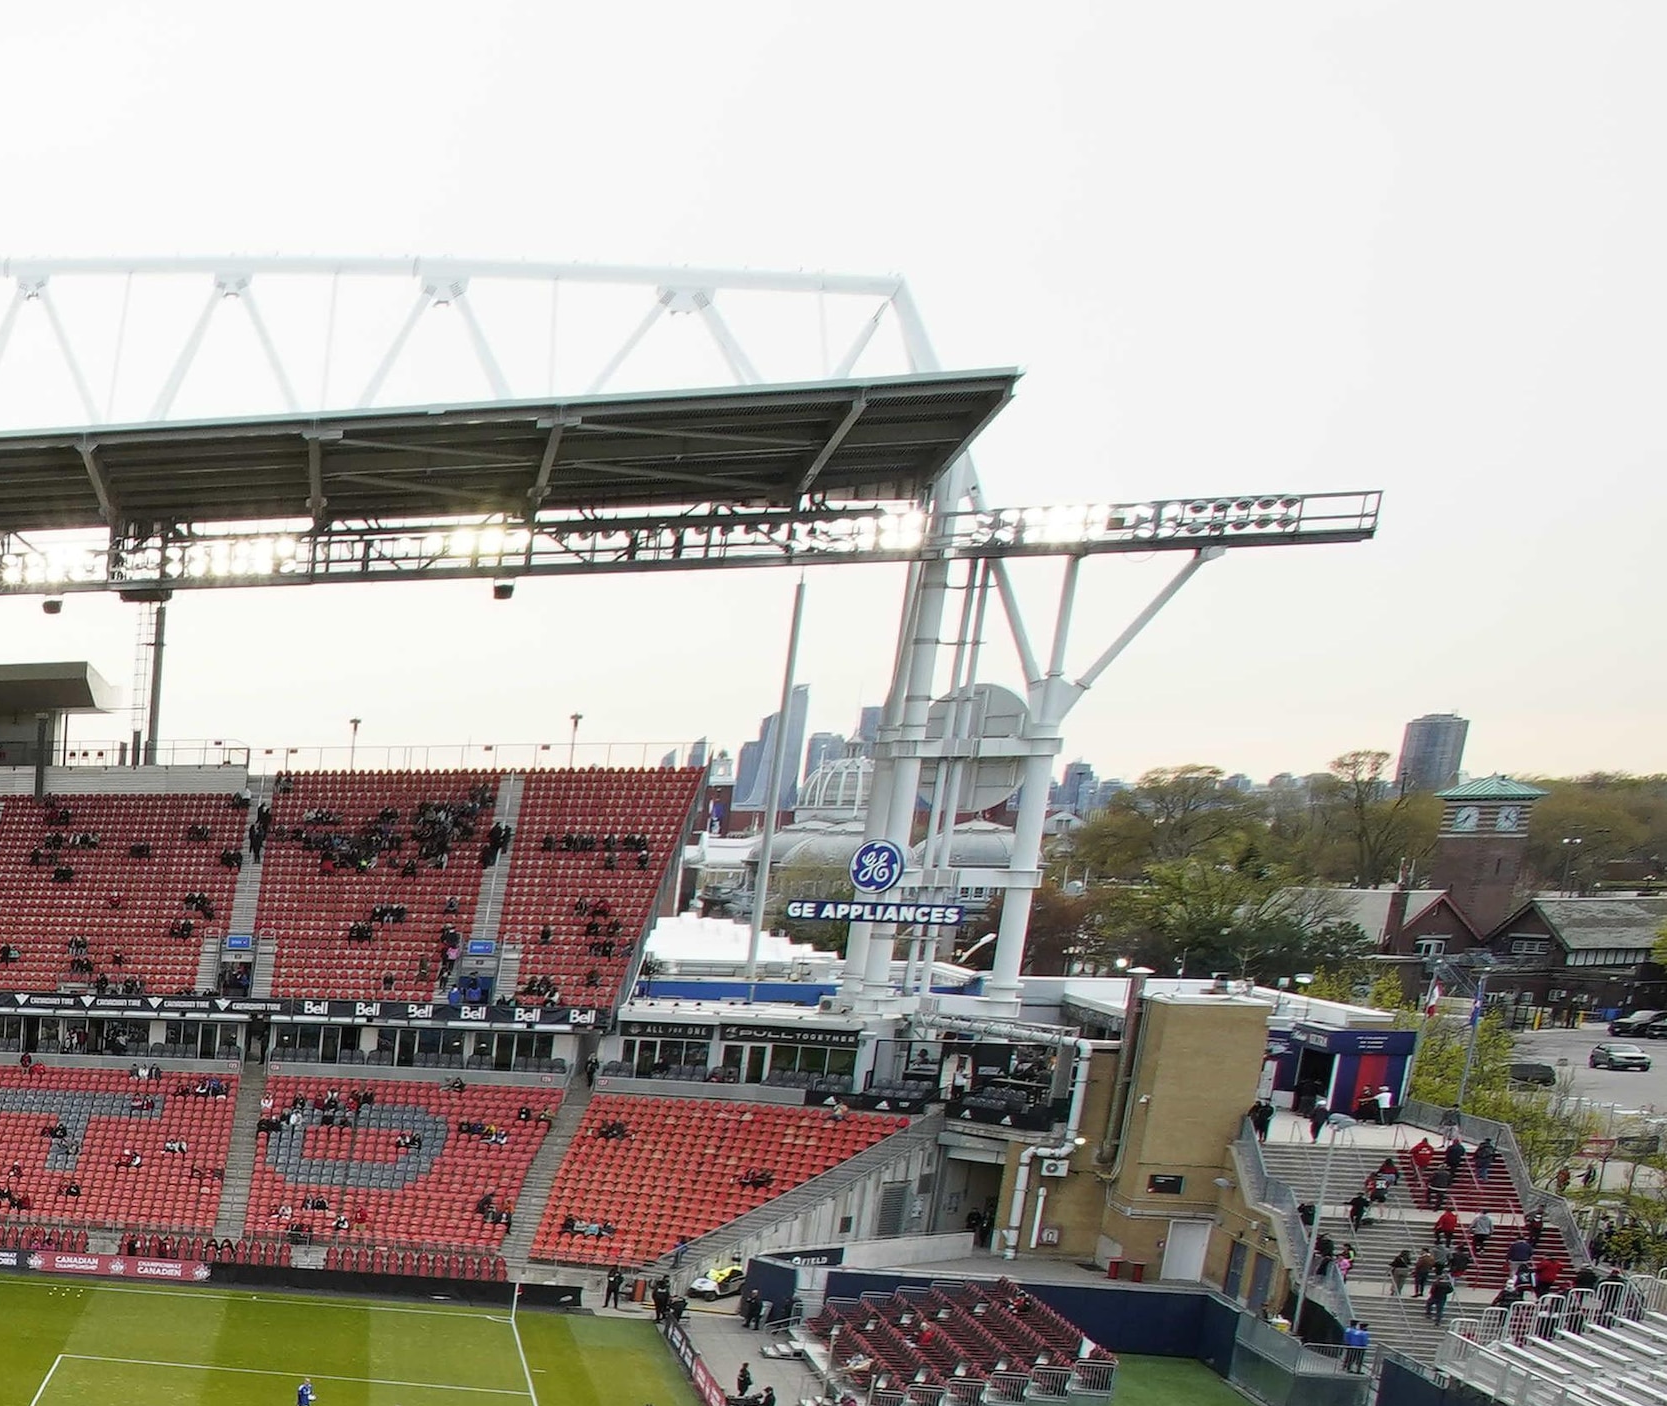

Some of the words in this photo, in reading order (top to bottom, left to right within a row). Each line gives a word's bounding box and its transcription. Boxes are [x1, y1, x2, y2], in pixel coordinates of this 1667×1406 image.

[787, 902, 816, 918] GE
[820, 904, 960, 924] APPLIANCES
[303, 1001, 329, 1015] Bell
[355, 1003, 380, 1016] Bell
[407, 1004, 433, 1018] Bell
[460, 1006, 486, 1020] Bell
[514, 1008, 541, 1022] Bell
[569, 1009, 596, 1024] Bell
[55, 1256, 98, 1265] CANADIAN
[137, 1267, 181, 1277] CANADIEN
